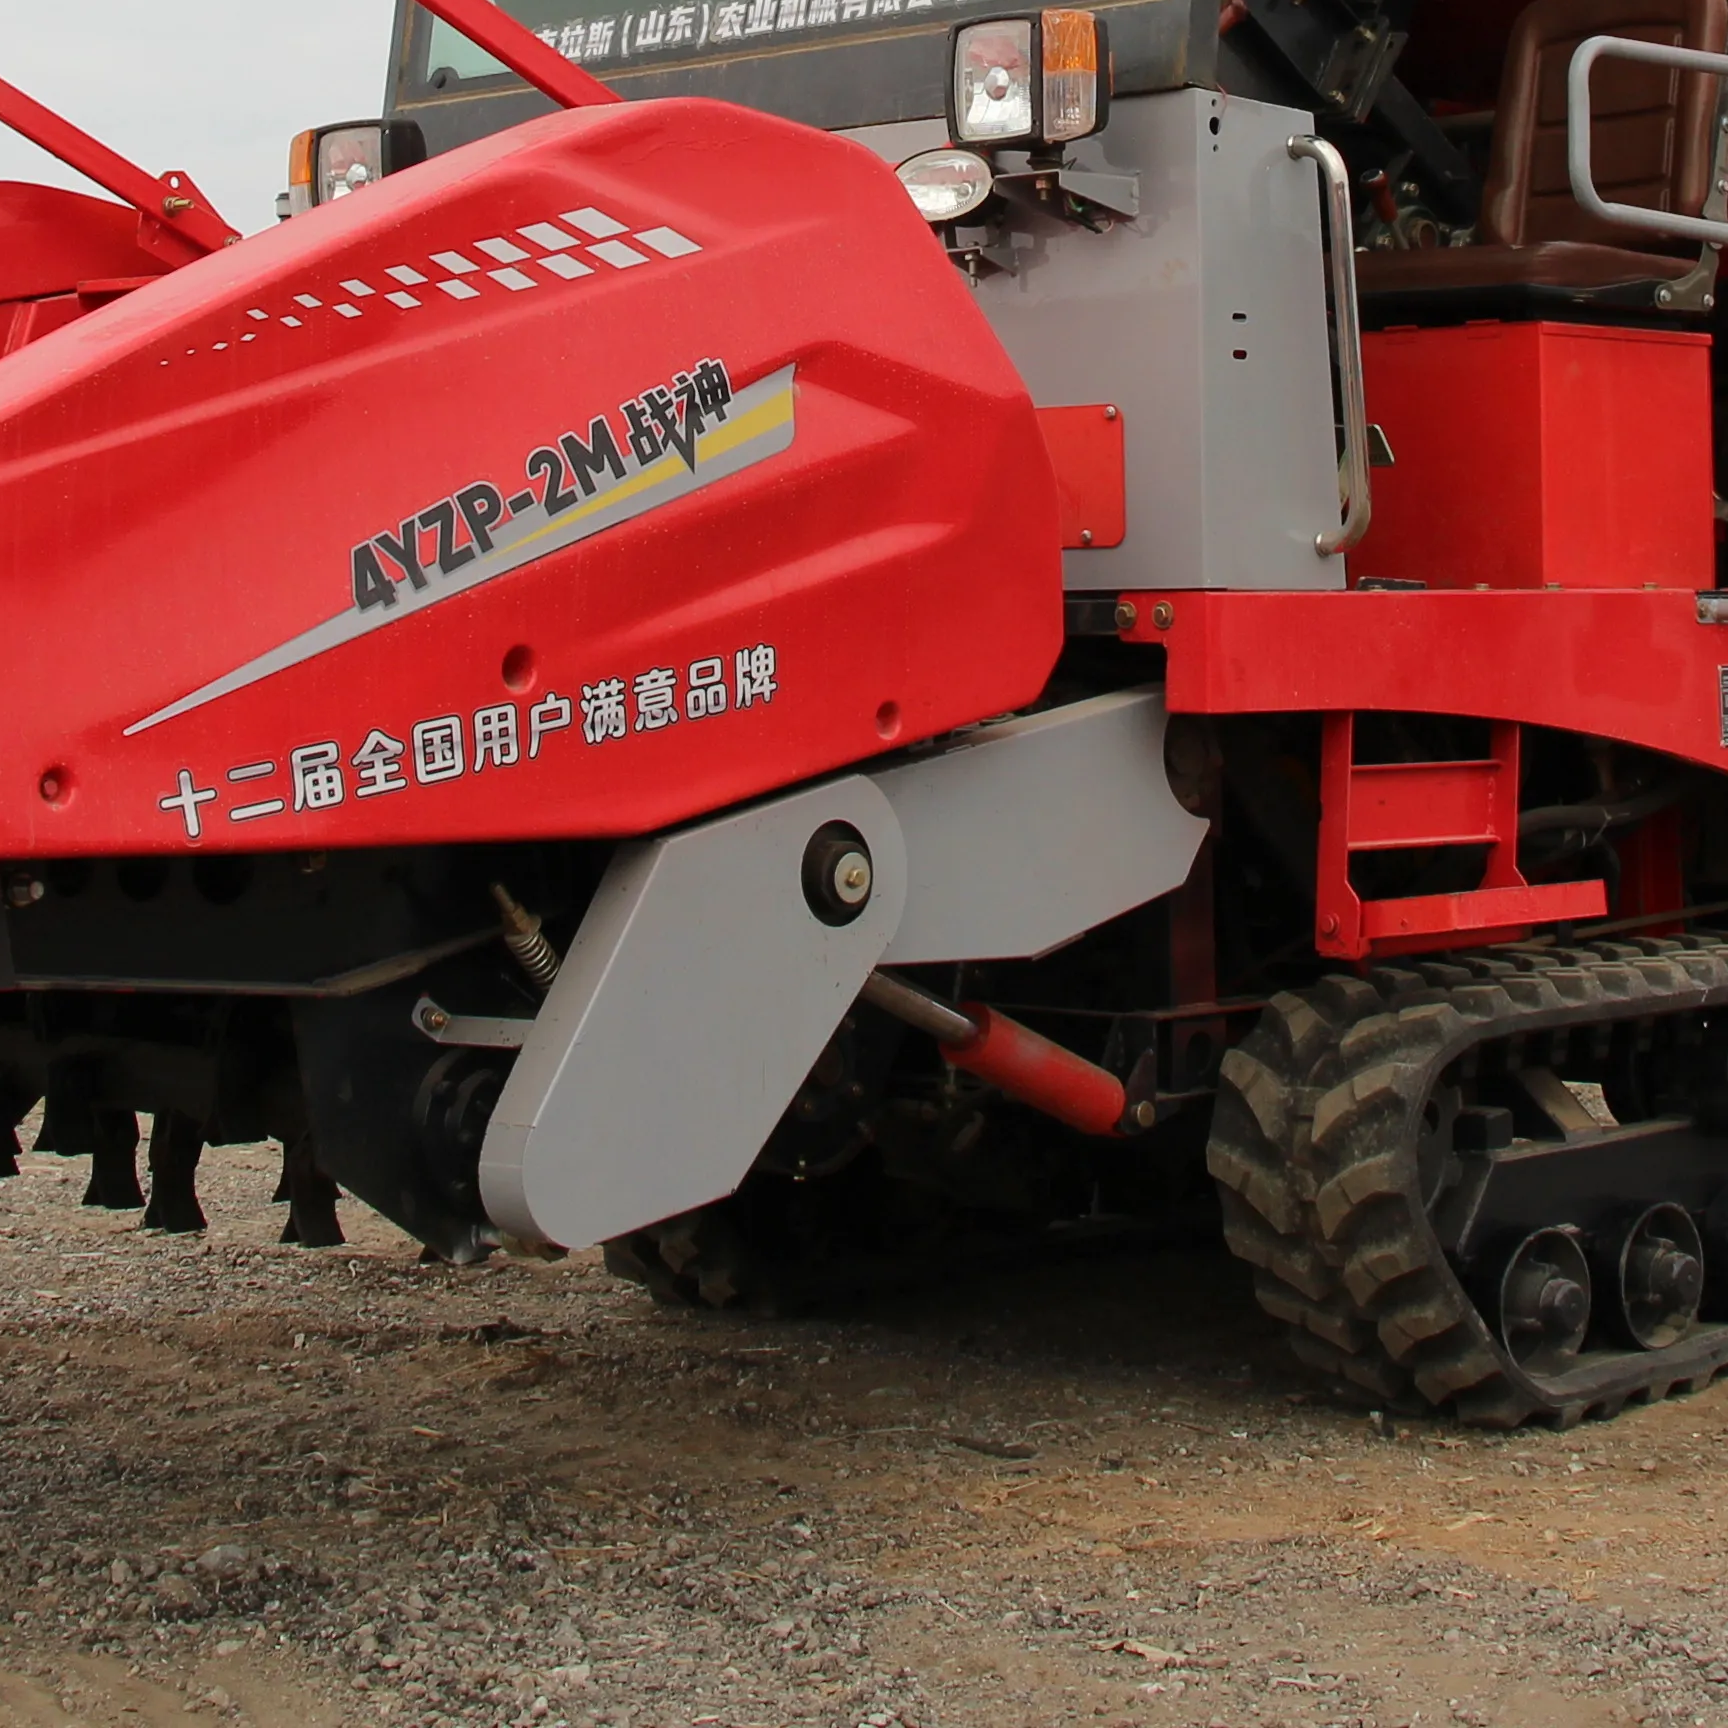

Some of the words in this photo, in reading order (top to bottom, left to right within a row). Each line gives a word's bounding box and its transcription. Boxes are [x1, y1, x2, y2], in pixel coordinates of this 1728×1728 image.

[350, 414, 628, 613] 4YZP-2M
[620, 358, 732, 474] 战神
[159, 643, 778, 840] 十二届全国用户满意品牌
